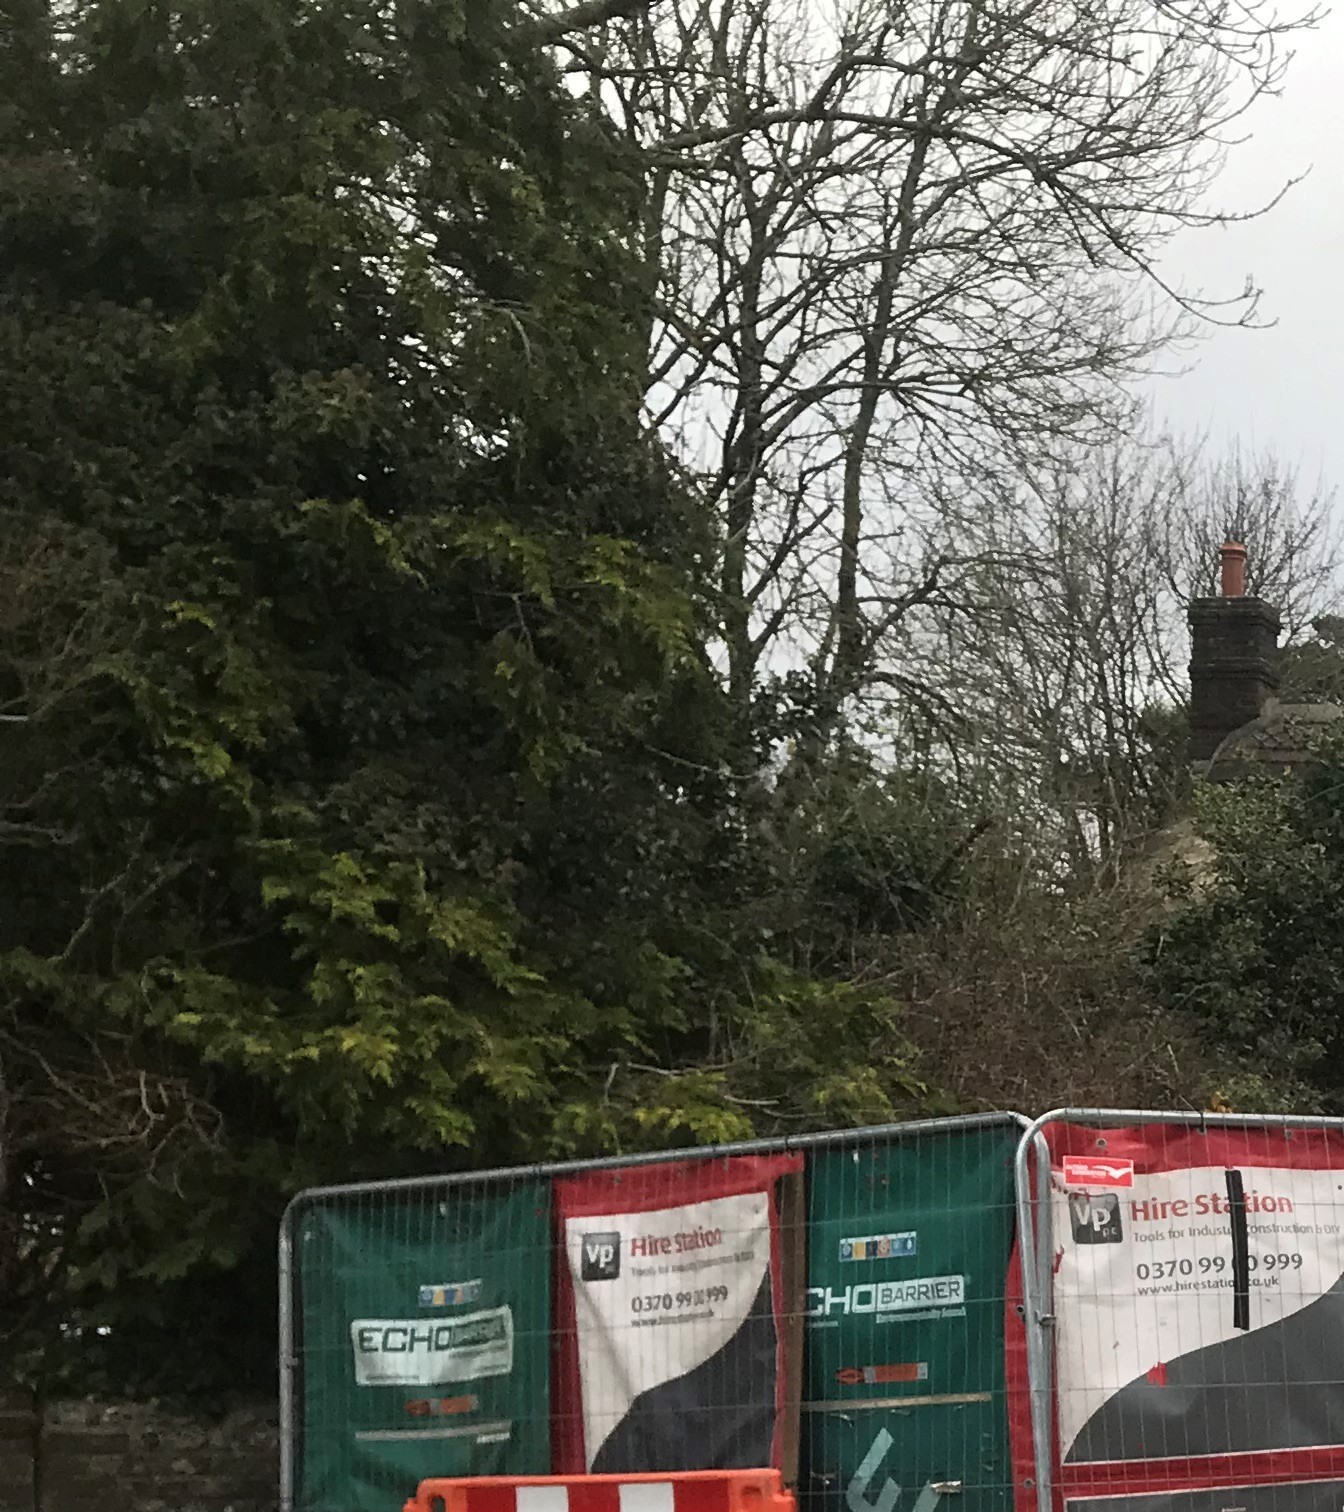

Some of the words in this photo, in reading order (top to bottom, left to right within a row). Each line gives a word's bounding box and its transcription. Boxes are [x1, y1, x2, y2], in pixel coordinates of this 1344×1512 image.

[1131, 1197, 1189, 1221] Hire
[631, 1234, 672, 1257] Hire
[674, 1226, 722, 1252] Station
[1134, 1231, 1164, 1244] Tools
[1136, 1258, 1193, 1280] 0370
[1199, 1256, 1225, 1273] 99
[1263, 1253, 1303, 1271] 999
[631, 1293, 673, 1313] 0370
[806, 1284, 876, 1316] CHO
[881, 1280, 960, 1304] BARRIER
[358, 1326, 452, 1352] ECHO
